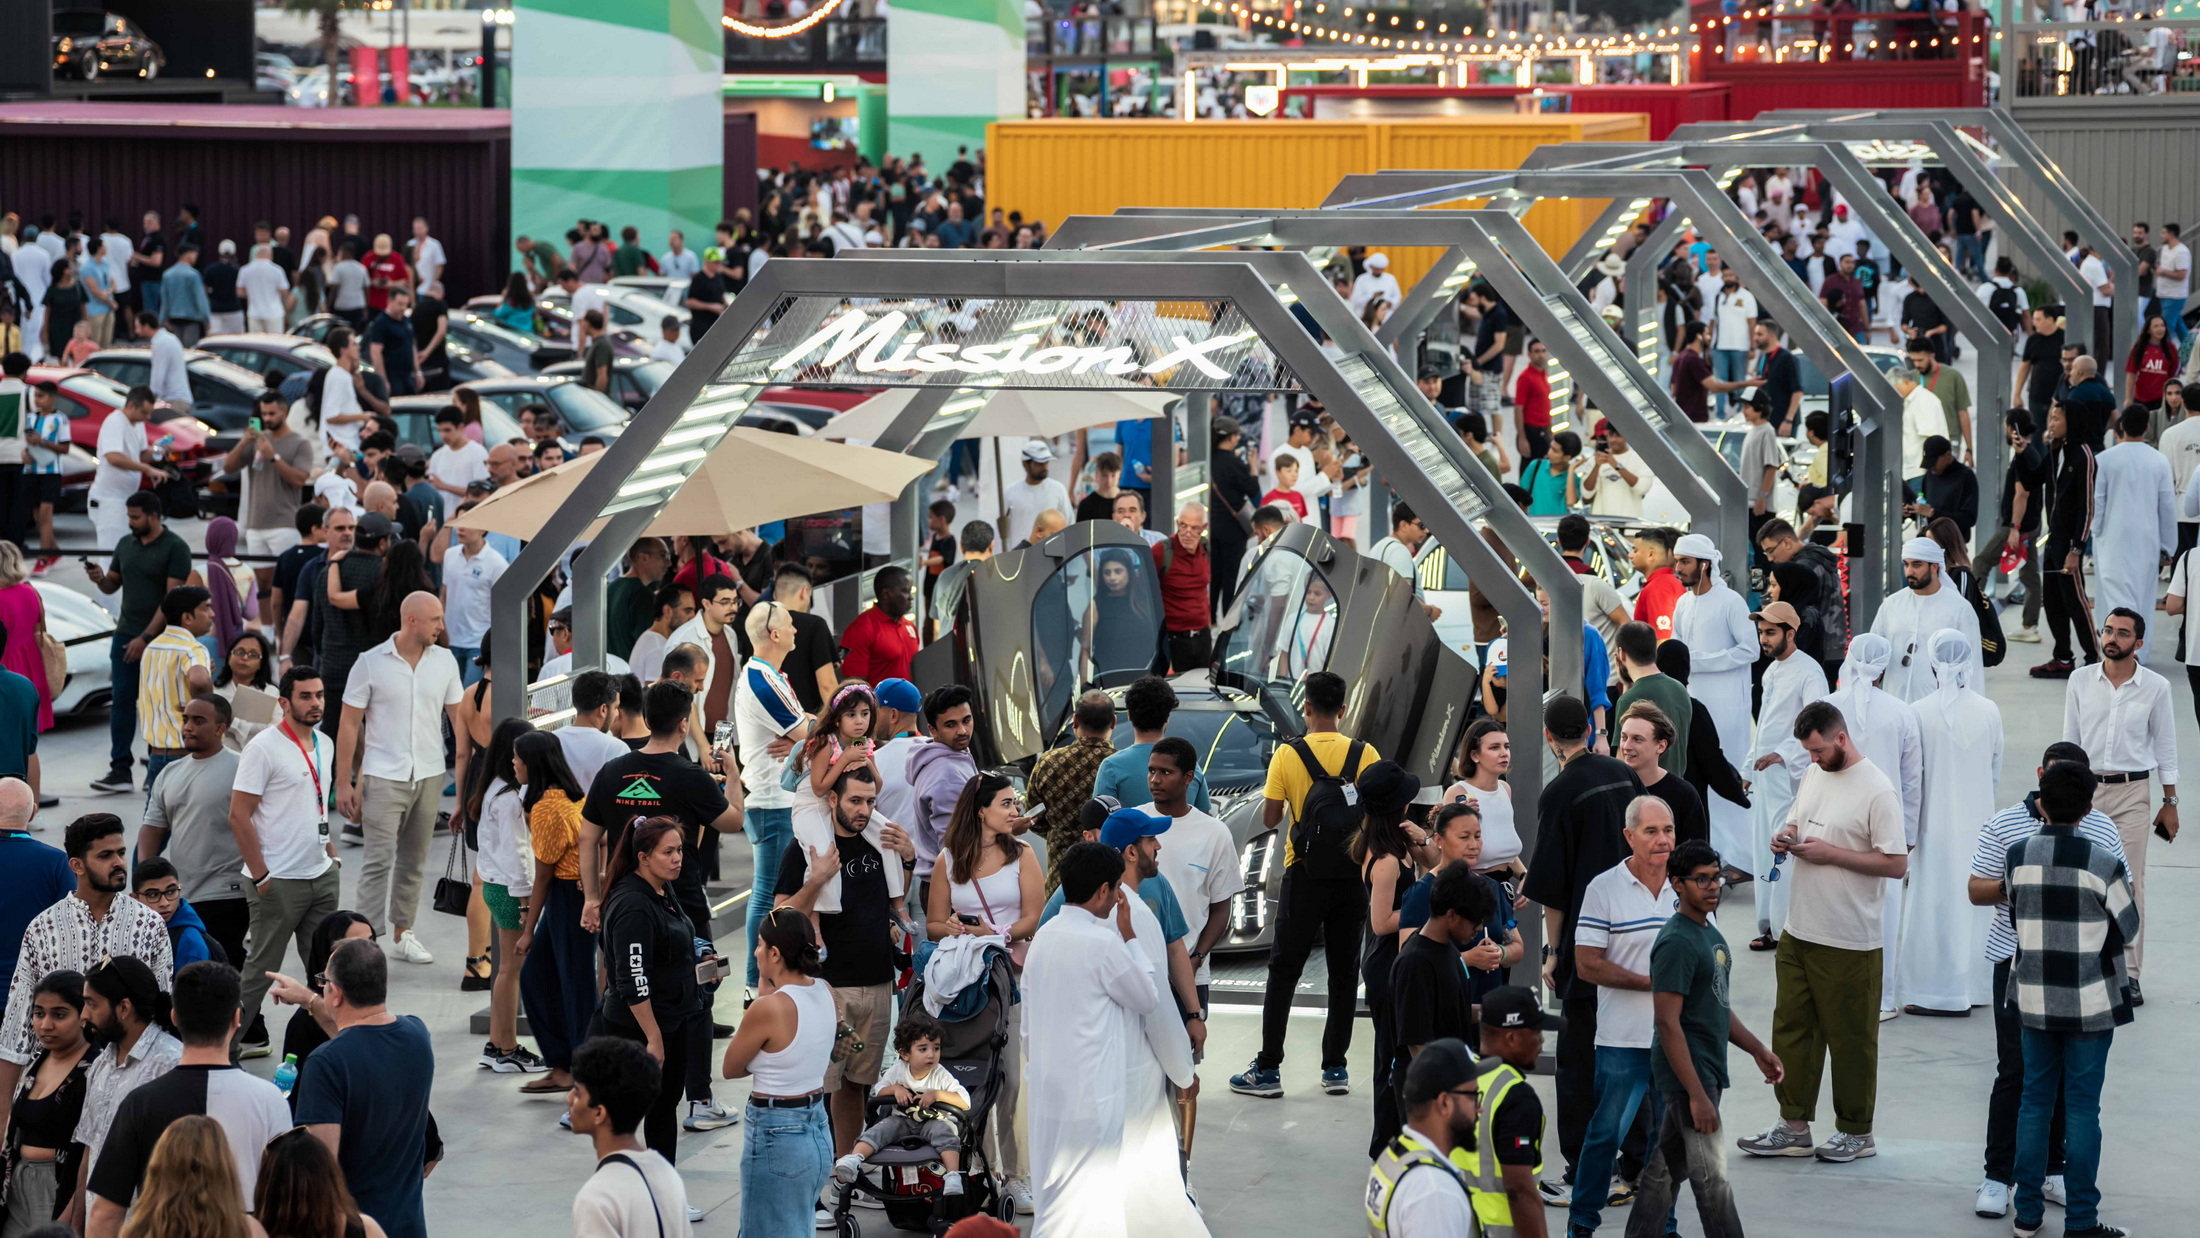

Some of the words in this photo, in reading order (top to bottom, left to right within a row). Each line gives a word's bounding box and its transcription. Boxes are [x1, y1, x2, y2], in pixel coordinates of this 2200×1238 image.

[770, 309, 1141, 375] Mission
[1142, 331, 1250, 381] X
[615, 798, 635, 806] NIKE
